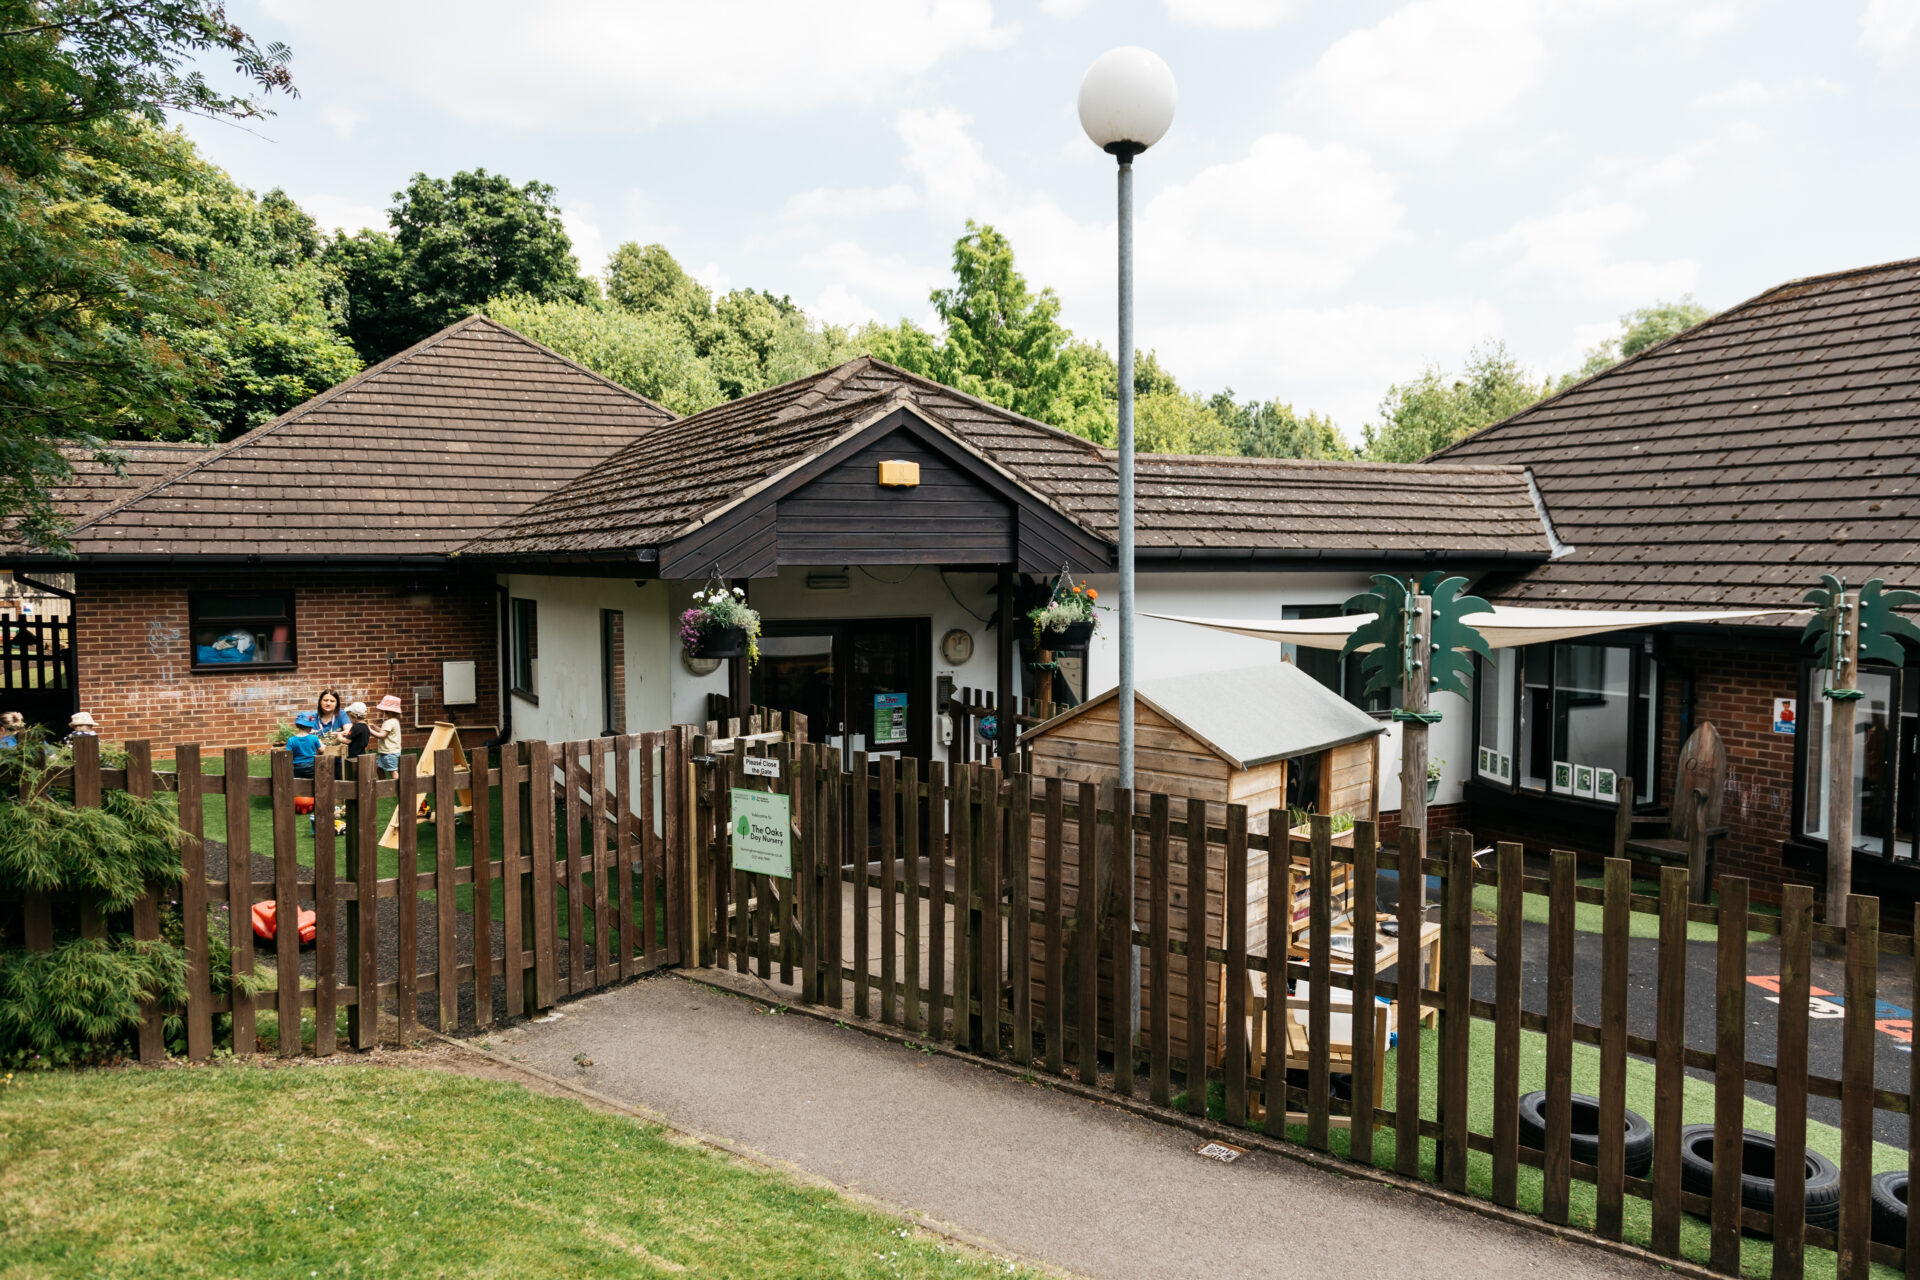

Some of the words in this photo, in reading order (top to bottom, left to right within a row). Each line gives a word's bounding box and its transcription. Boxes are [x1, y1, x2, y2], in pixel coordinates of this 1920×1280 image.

[745, 758, 761, 766] Please
[762, 760, 777, 768] Close
[751, 824, 764, 834] The
[764, 826, 783, 837] Oaks
[750, 833, 762, 843] Day
[762, 835, 784, 846] Nursery
